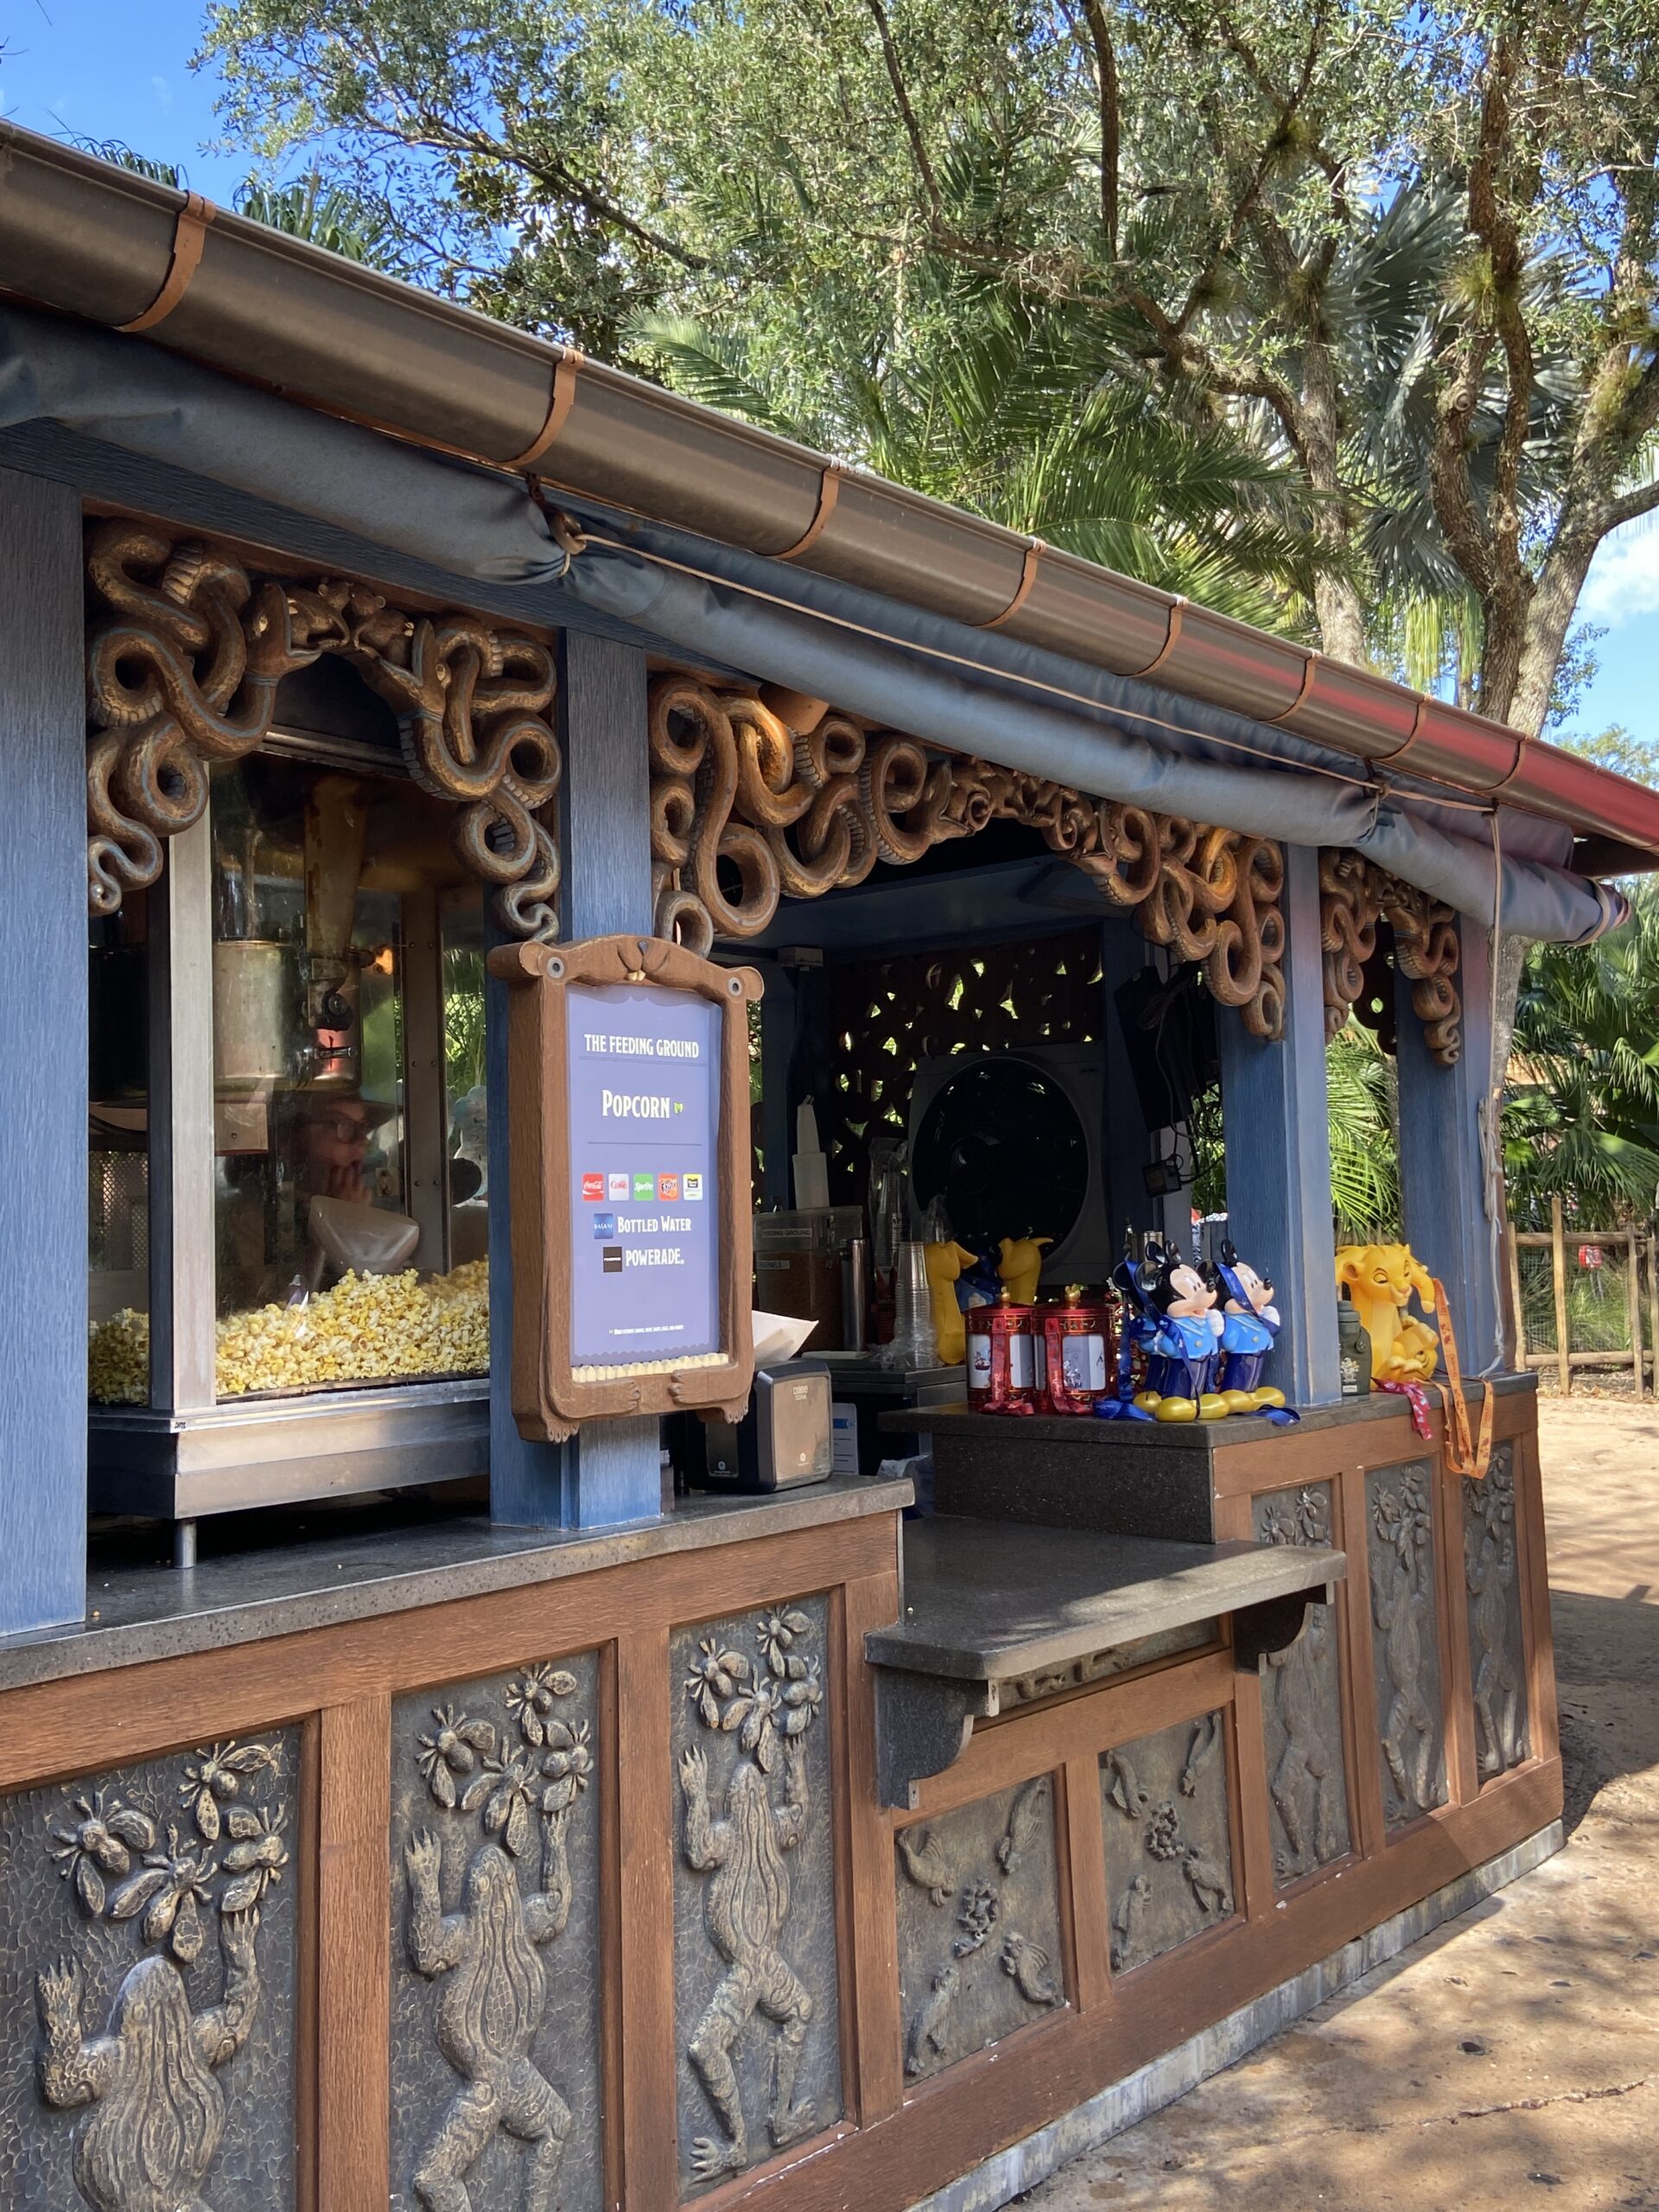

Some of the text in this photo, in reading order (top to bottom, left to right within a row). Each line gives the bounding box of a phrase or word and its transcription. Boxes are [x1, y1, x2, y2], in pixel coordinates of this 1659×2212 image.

[584, 1033, 699, 1058] THE FEEDING GROUND
[601, 1089, 671, 1118] POPCORN
[634, 1181, 653, 1192] Sprite
[617, 1215, 692, 1234] BOTTLED WATER
